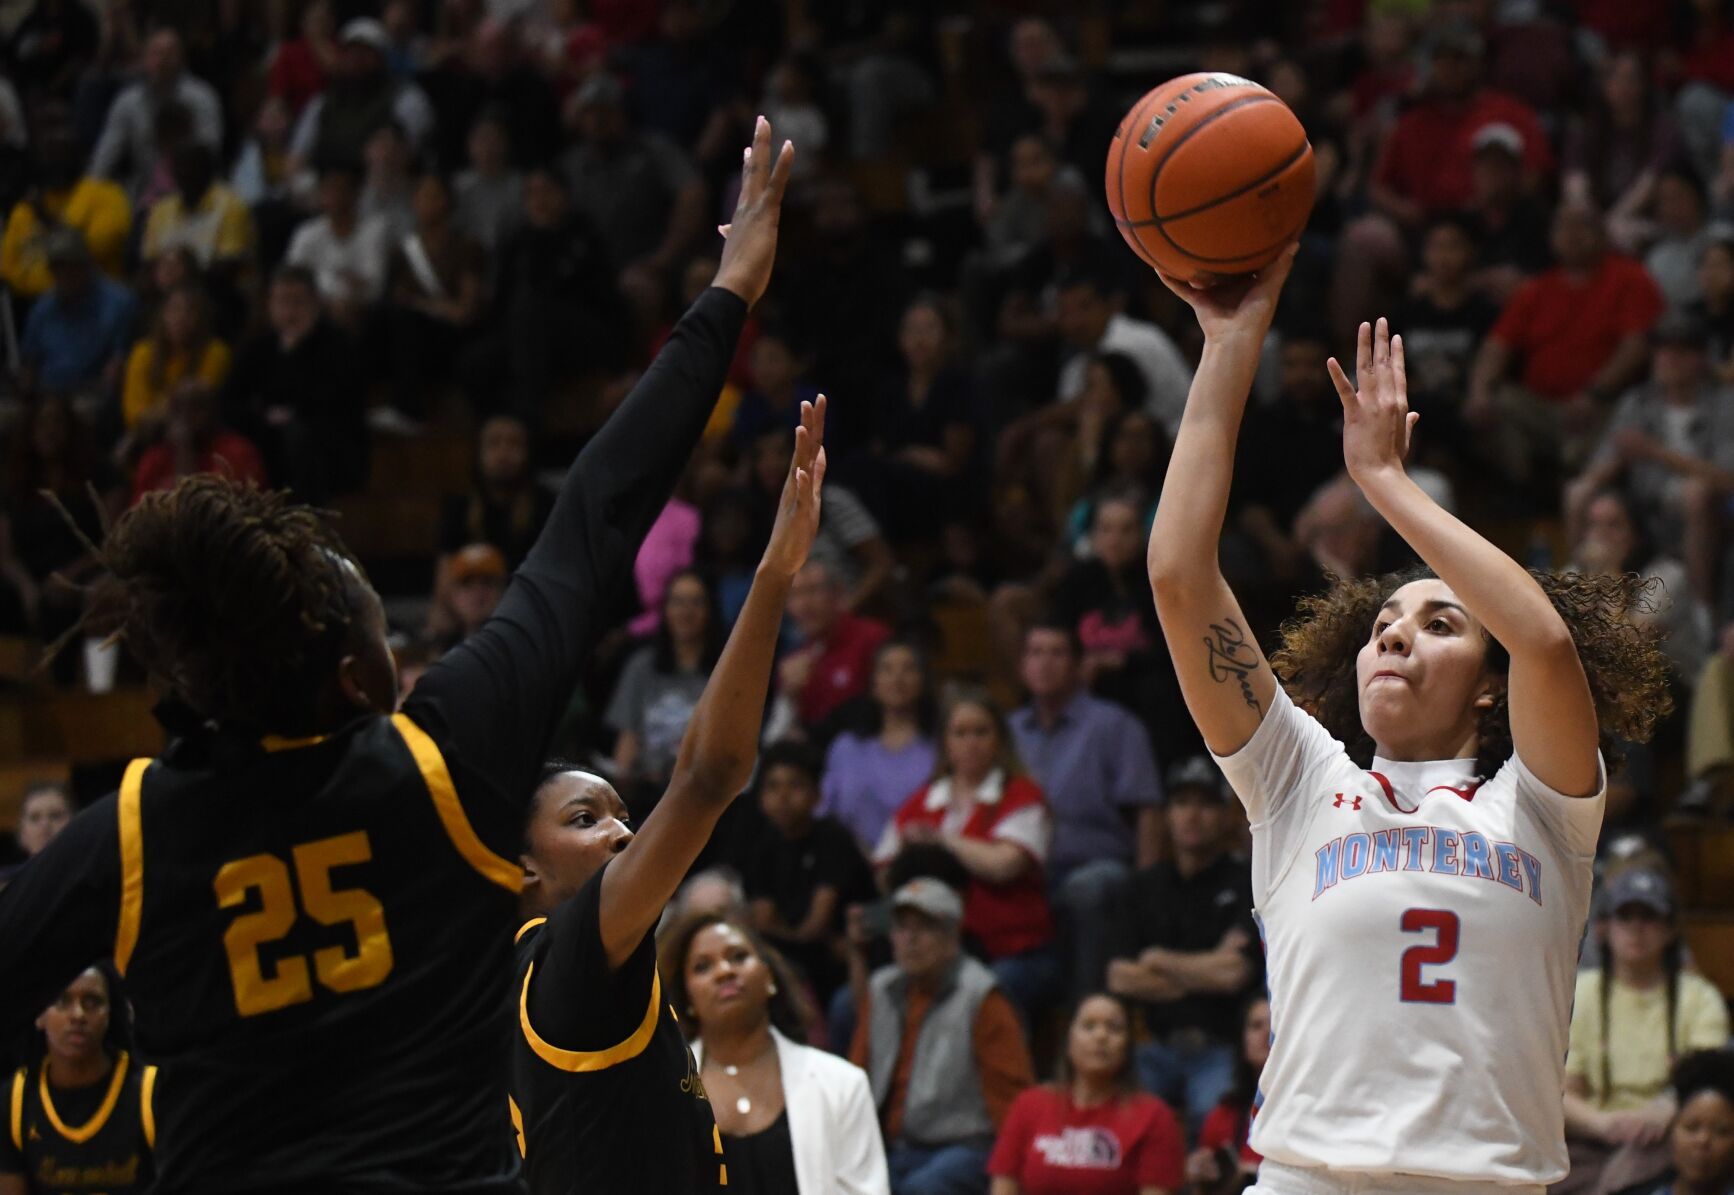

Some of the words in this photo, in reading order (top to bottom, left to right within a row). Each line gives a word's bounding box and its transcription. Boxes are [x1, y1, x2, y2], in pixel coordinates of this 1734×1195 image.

[1312, 826, 1542, 907] MONTEREY
[213, 829, 395, 1018] 25
[1401, 907, 1460, 1005] 2
